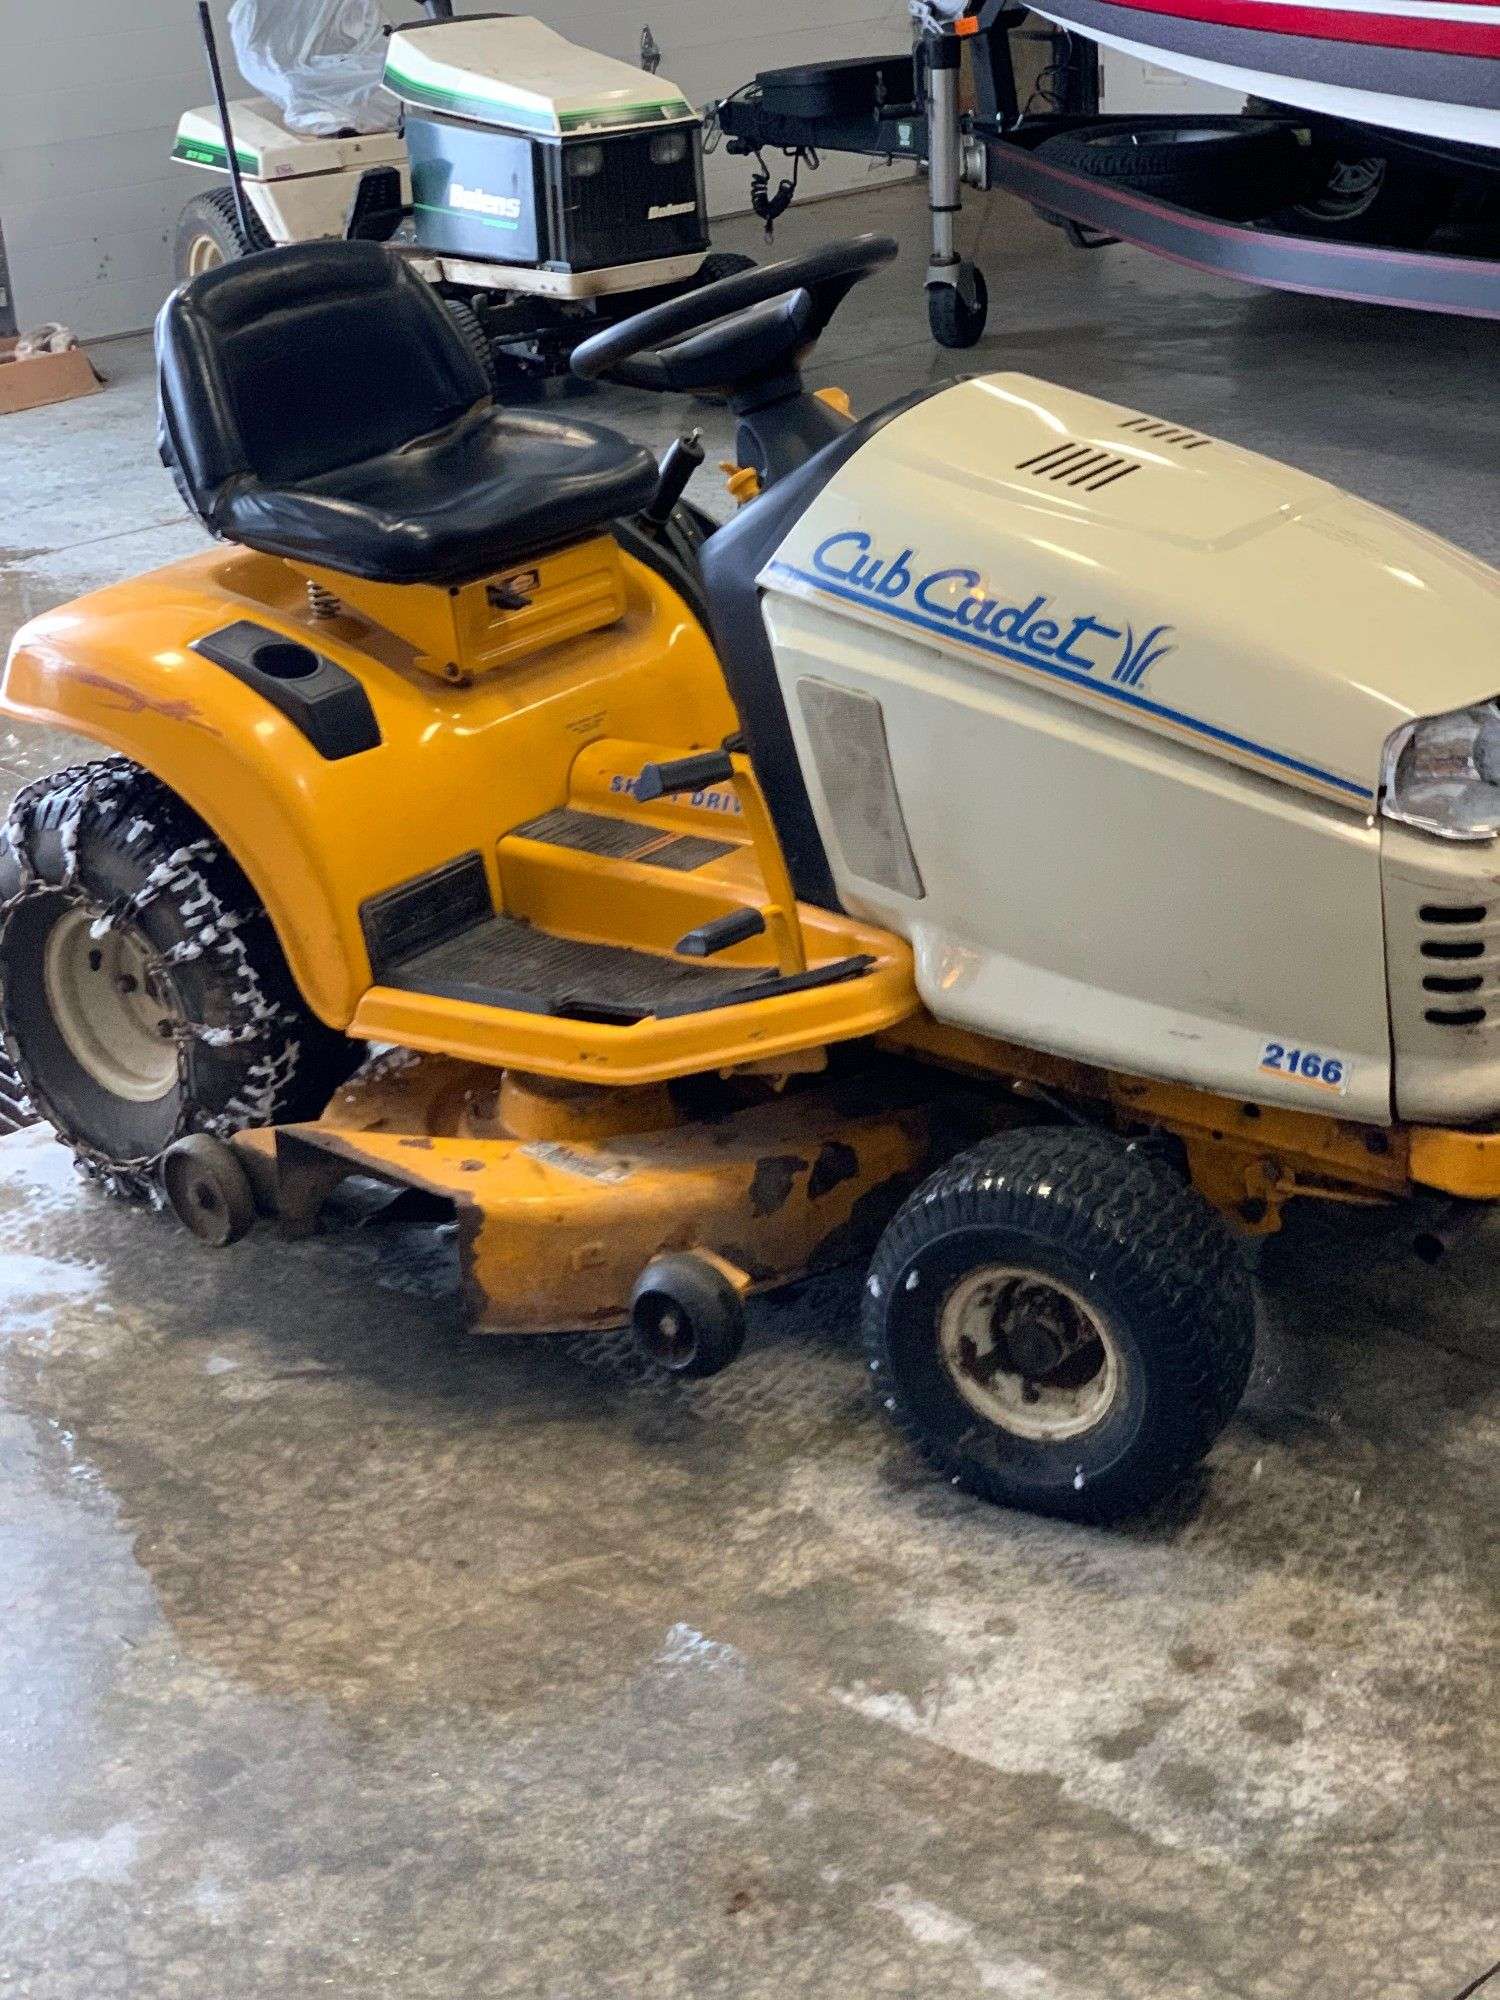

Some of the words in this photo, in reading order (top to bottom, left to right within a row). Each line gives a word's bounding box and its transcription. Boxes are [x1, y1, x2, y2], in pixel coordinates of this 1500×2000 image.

[813, 530, 913, 598] Cub
[914, 568, 1122, 671] Cadet
[1262, 1043, 1343, 1084] 2166
